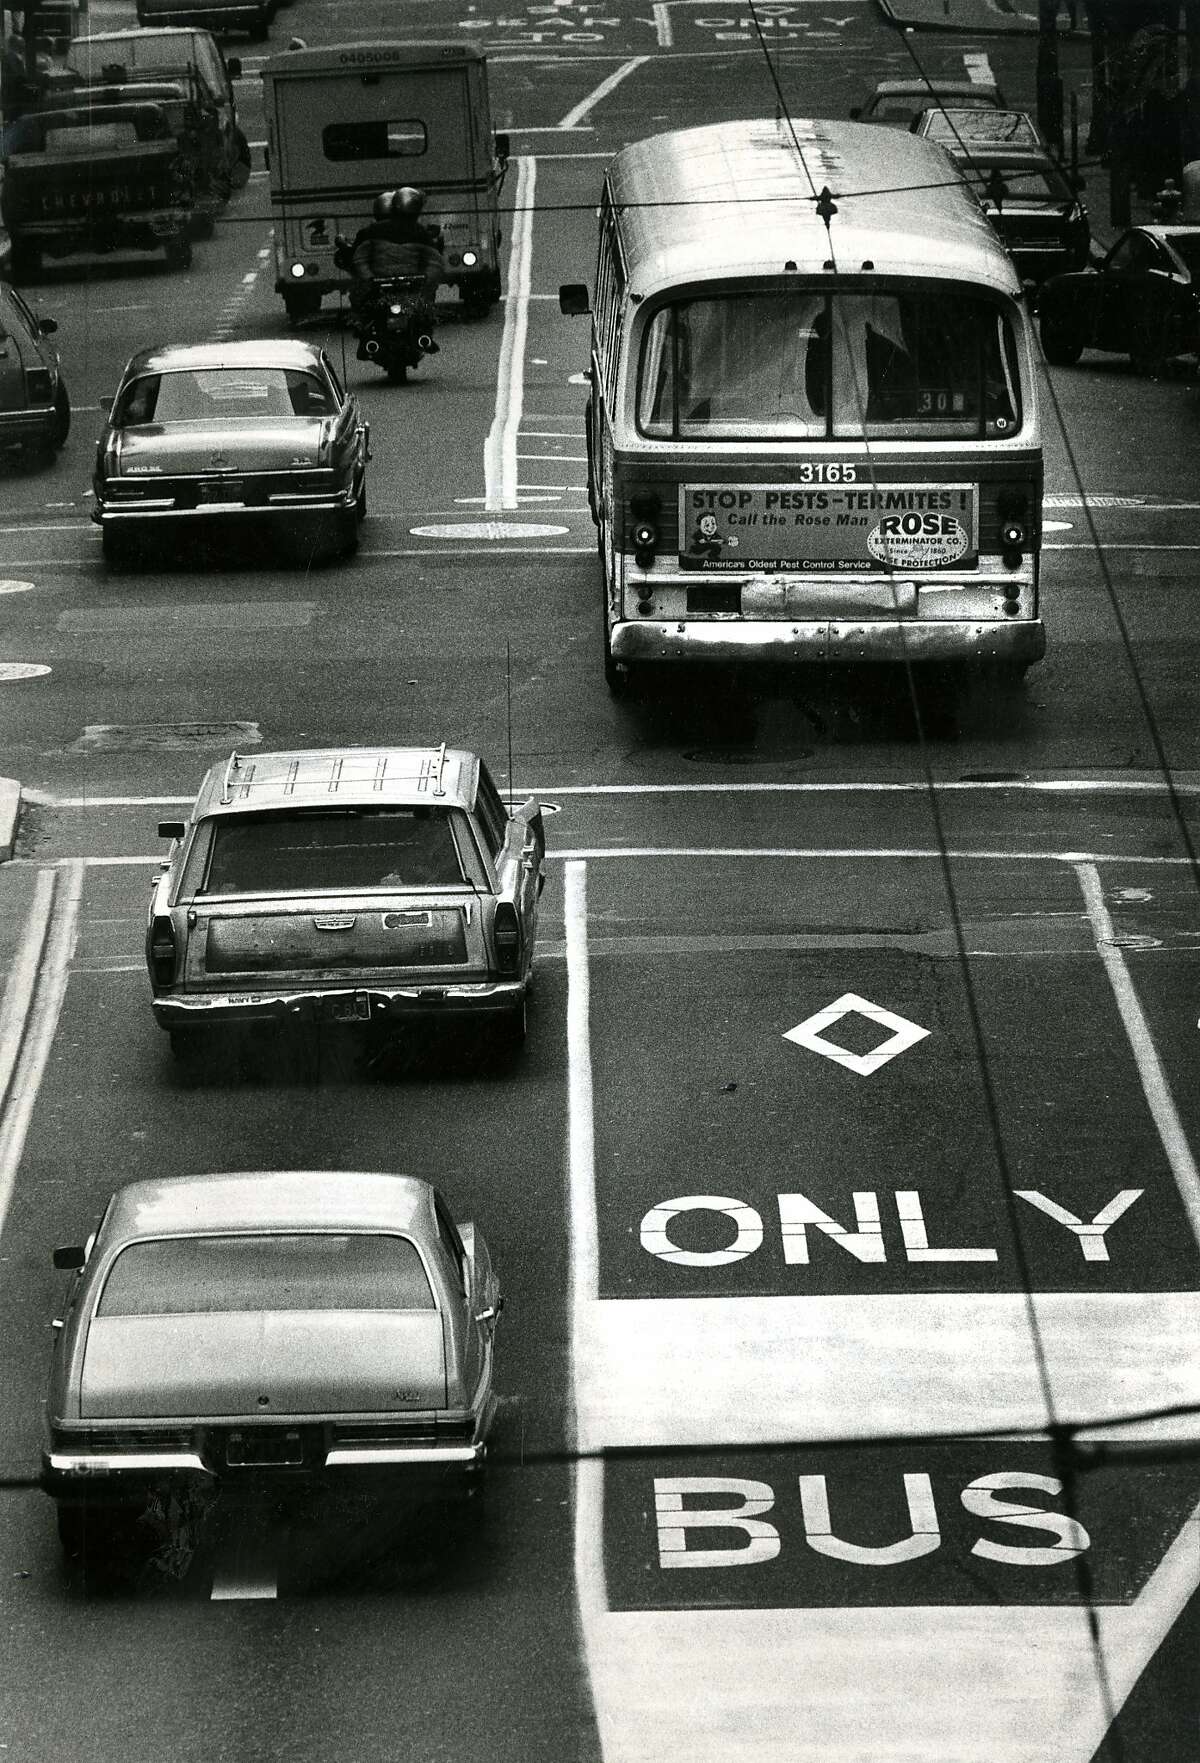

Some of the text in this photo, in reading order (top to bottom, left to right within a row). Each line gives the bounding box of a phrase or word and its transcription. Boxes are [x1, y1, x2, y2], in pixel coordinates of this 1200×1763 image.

[694, 17, 861, 28] ONLY
[799, 463, 857, 483] 3165
[692, 490, 753, 509] STOP
[727, 513, 869, 526] Call the Rose Man
[879, 512, 958, 535] ROSE
[874, 537, 943, 545] EXTERMINATOR
[702, 559, 872, 570] America's Oldest Pest Control Service
[878, 552, 957, 568] WSE PROTECTION
[639, 1188, 1145, 1268] ONLY
[653, 1471, 1092, 1570] BUS
